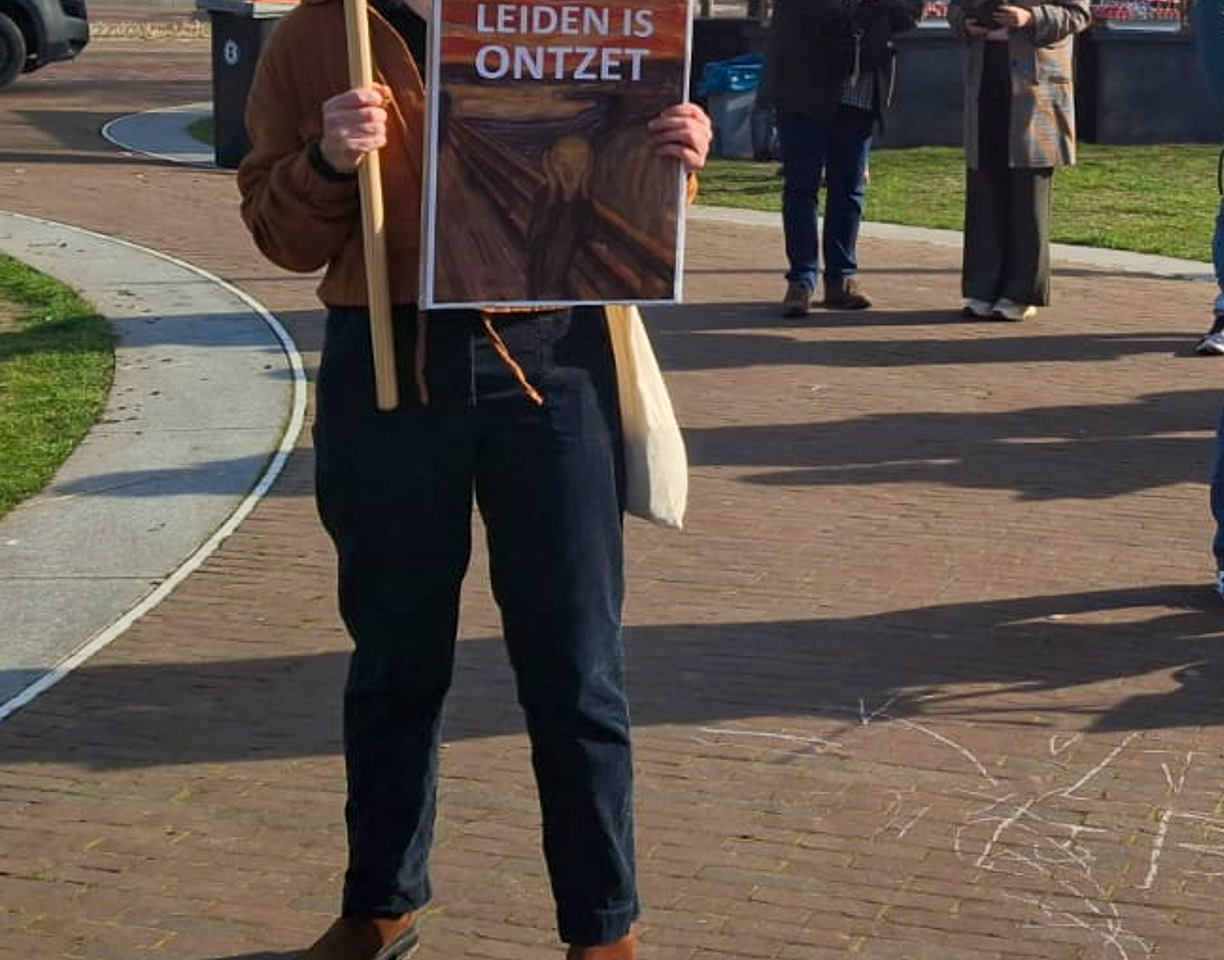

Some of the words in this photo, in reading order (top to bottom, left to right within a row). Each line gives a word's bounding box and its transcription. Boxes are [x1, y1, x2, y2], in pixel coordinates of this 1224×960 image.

[476, 3, 609, 36] LEIDEN
[624, 8, 654, 38] IS
[475, 44, 650, 81] ONTZET
